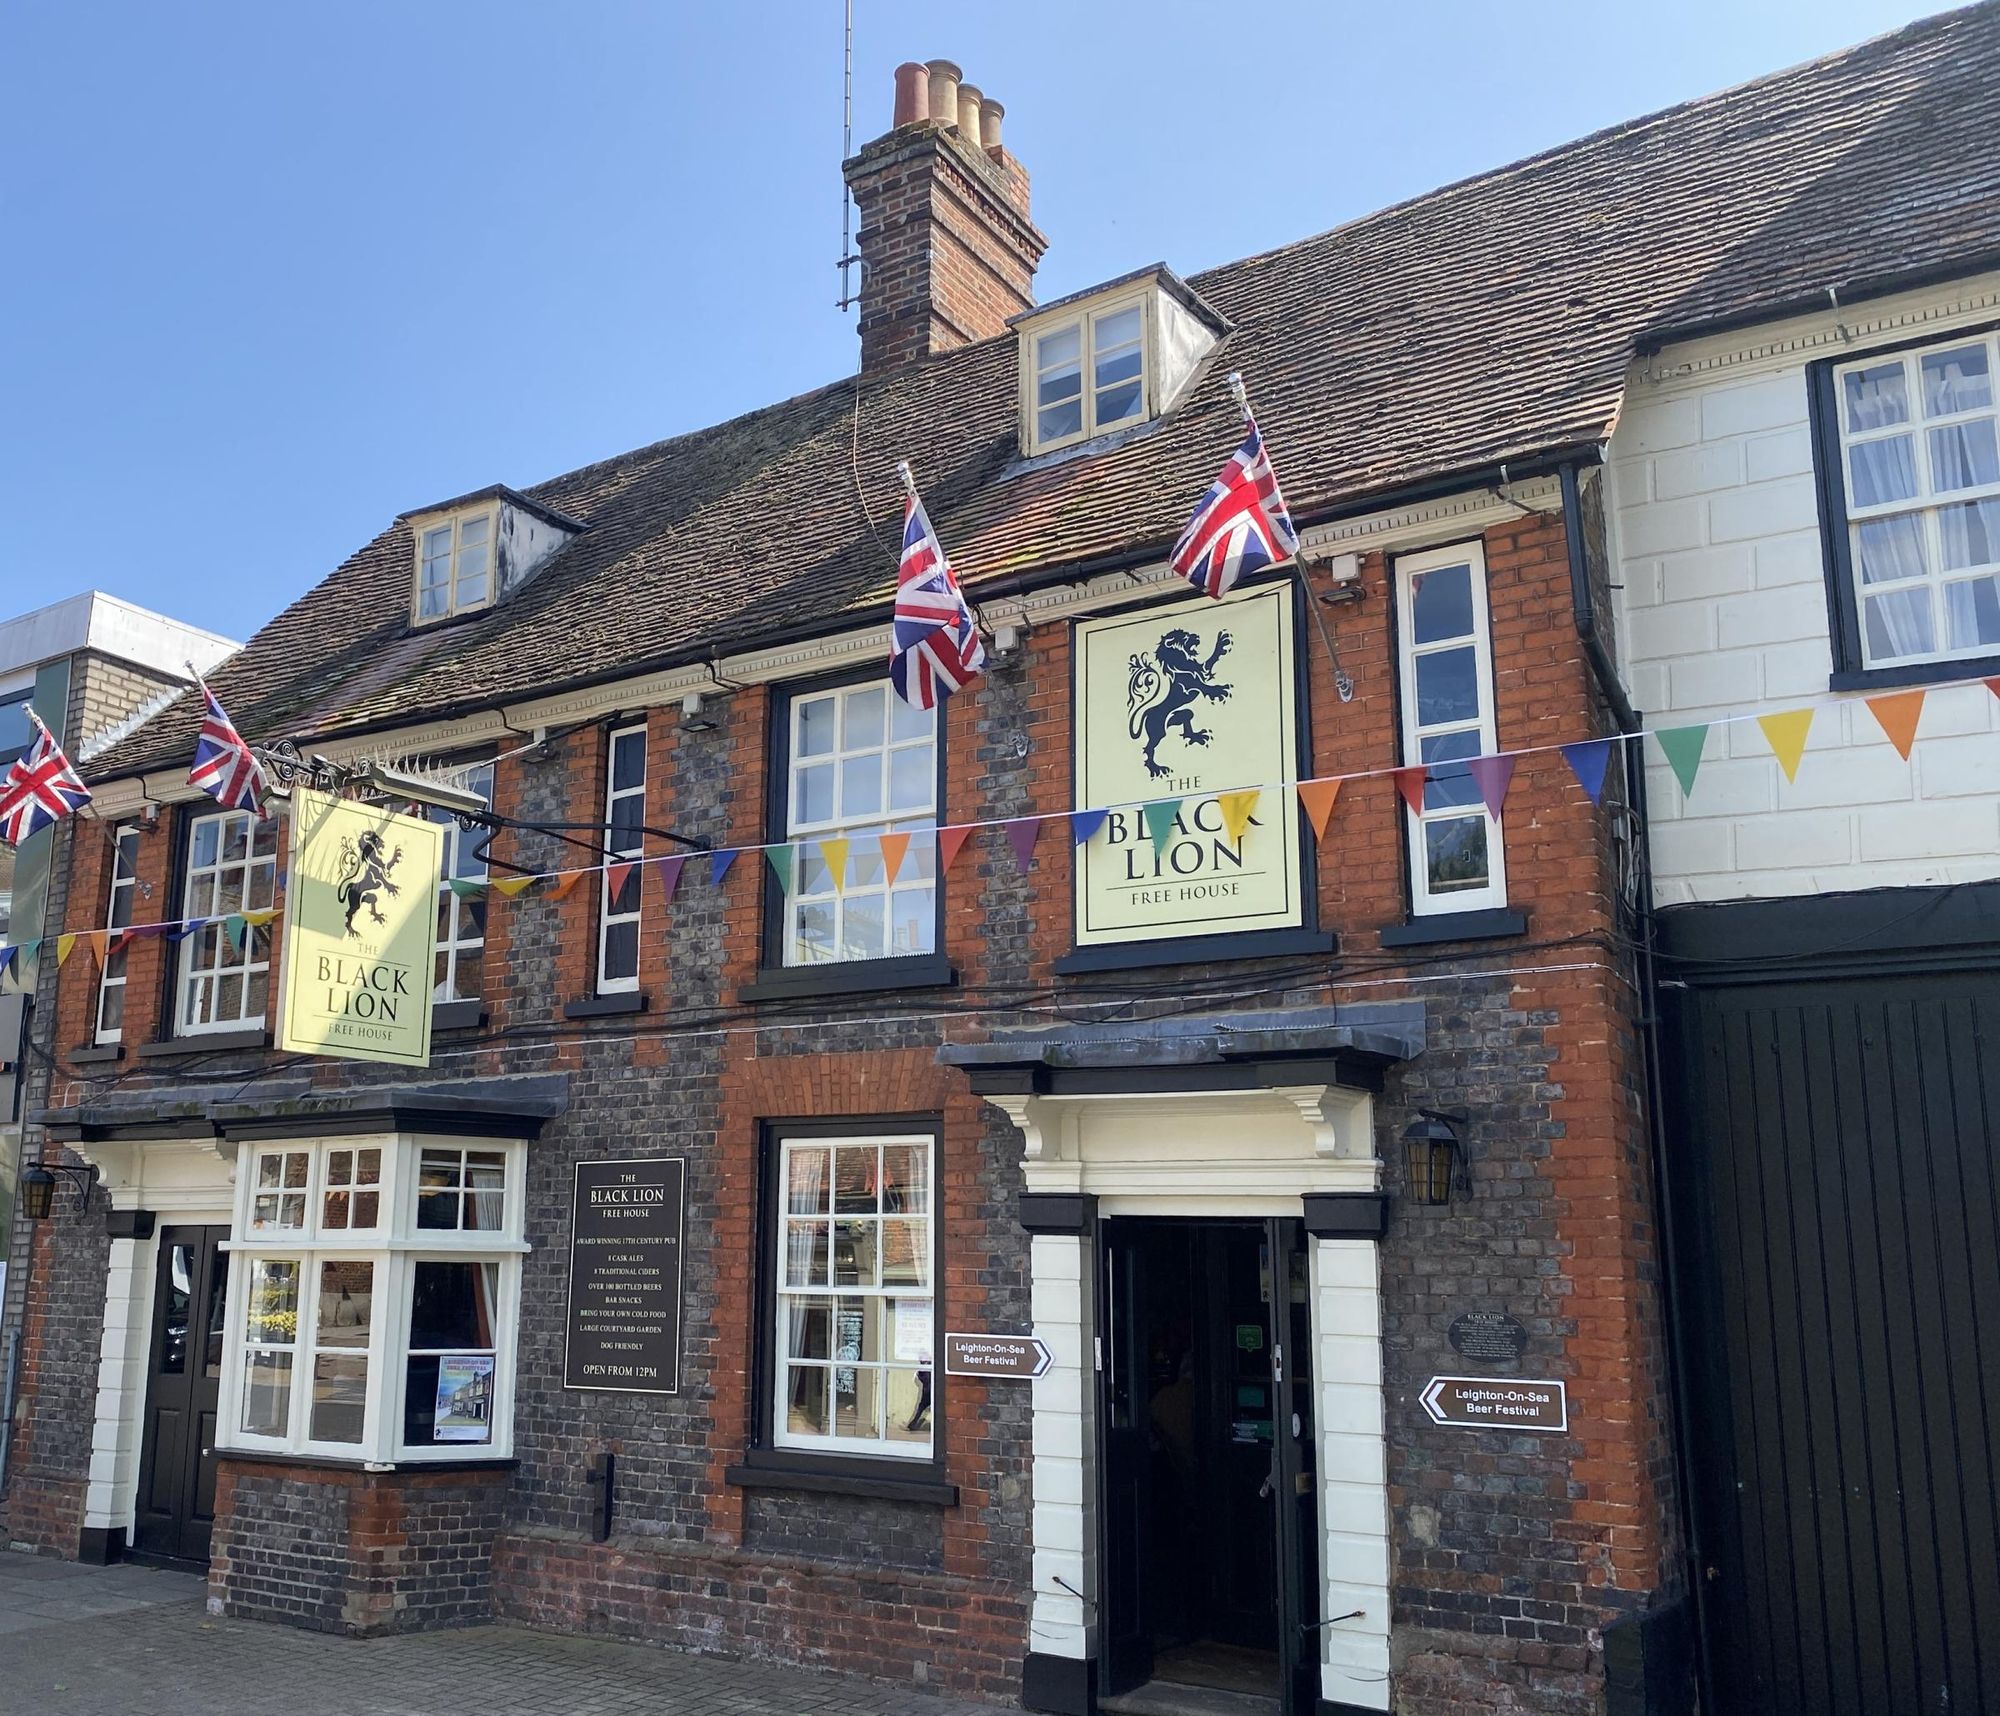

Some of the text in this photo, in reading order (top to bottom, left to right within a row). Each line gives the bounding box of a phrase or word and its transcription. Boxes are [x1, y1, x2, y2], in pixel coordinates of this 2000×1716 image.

[1166, 776, 1201, 792] THE
[1124, 835, 1245, 880] LION
[1131, 883, 1240, 906] FREE HOUSE
[357, 942, 379, 955] THE
[317, 955, 410, 996] BLACK
[327, 987, 399, 1022] LION
[328, 1023, 393, 1041] FREE HOUSE
[620, 1174, 636, 1183] THE
[590, 1188, 664, 1203] BLACK LION
[602, 1208, 649, 1218] FREE HOUSE
[597, 1237, 621, 1245] WINNING
[636, 1237, 663, 1245] CENTURY
[664, 1237, 677, 1245] PUB
[615, 1283, 642, 1291] BOTTLED
[643, 1283, 662, 1291] BEERS
[605, 1296, 617, 1304] BAR
[580, 1309, 598, 1317] BRING
[616, 1310, 631, 1318] OWN
[631, 1310, 648, 1318] COLD
[649, 1311, 667, 1319] FOOD
[579, 1324, 662, 1334] LARGE COURTYARD GARDEN
[614, 1342, 643, 1350] FRIENDLY
[955, 1342, 1025, 1354] Leighton-On-Sea
[963, 1354, 1018, 1366] Beer Festival
[583, 1364, 657, 1377] OPEN FROM 12PM
[1455, 1388, 1550, 1403] Leighton-On-Sea
[1466, 1403, 1540, 1417] Beer Festival
